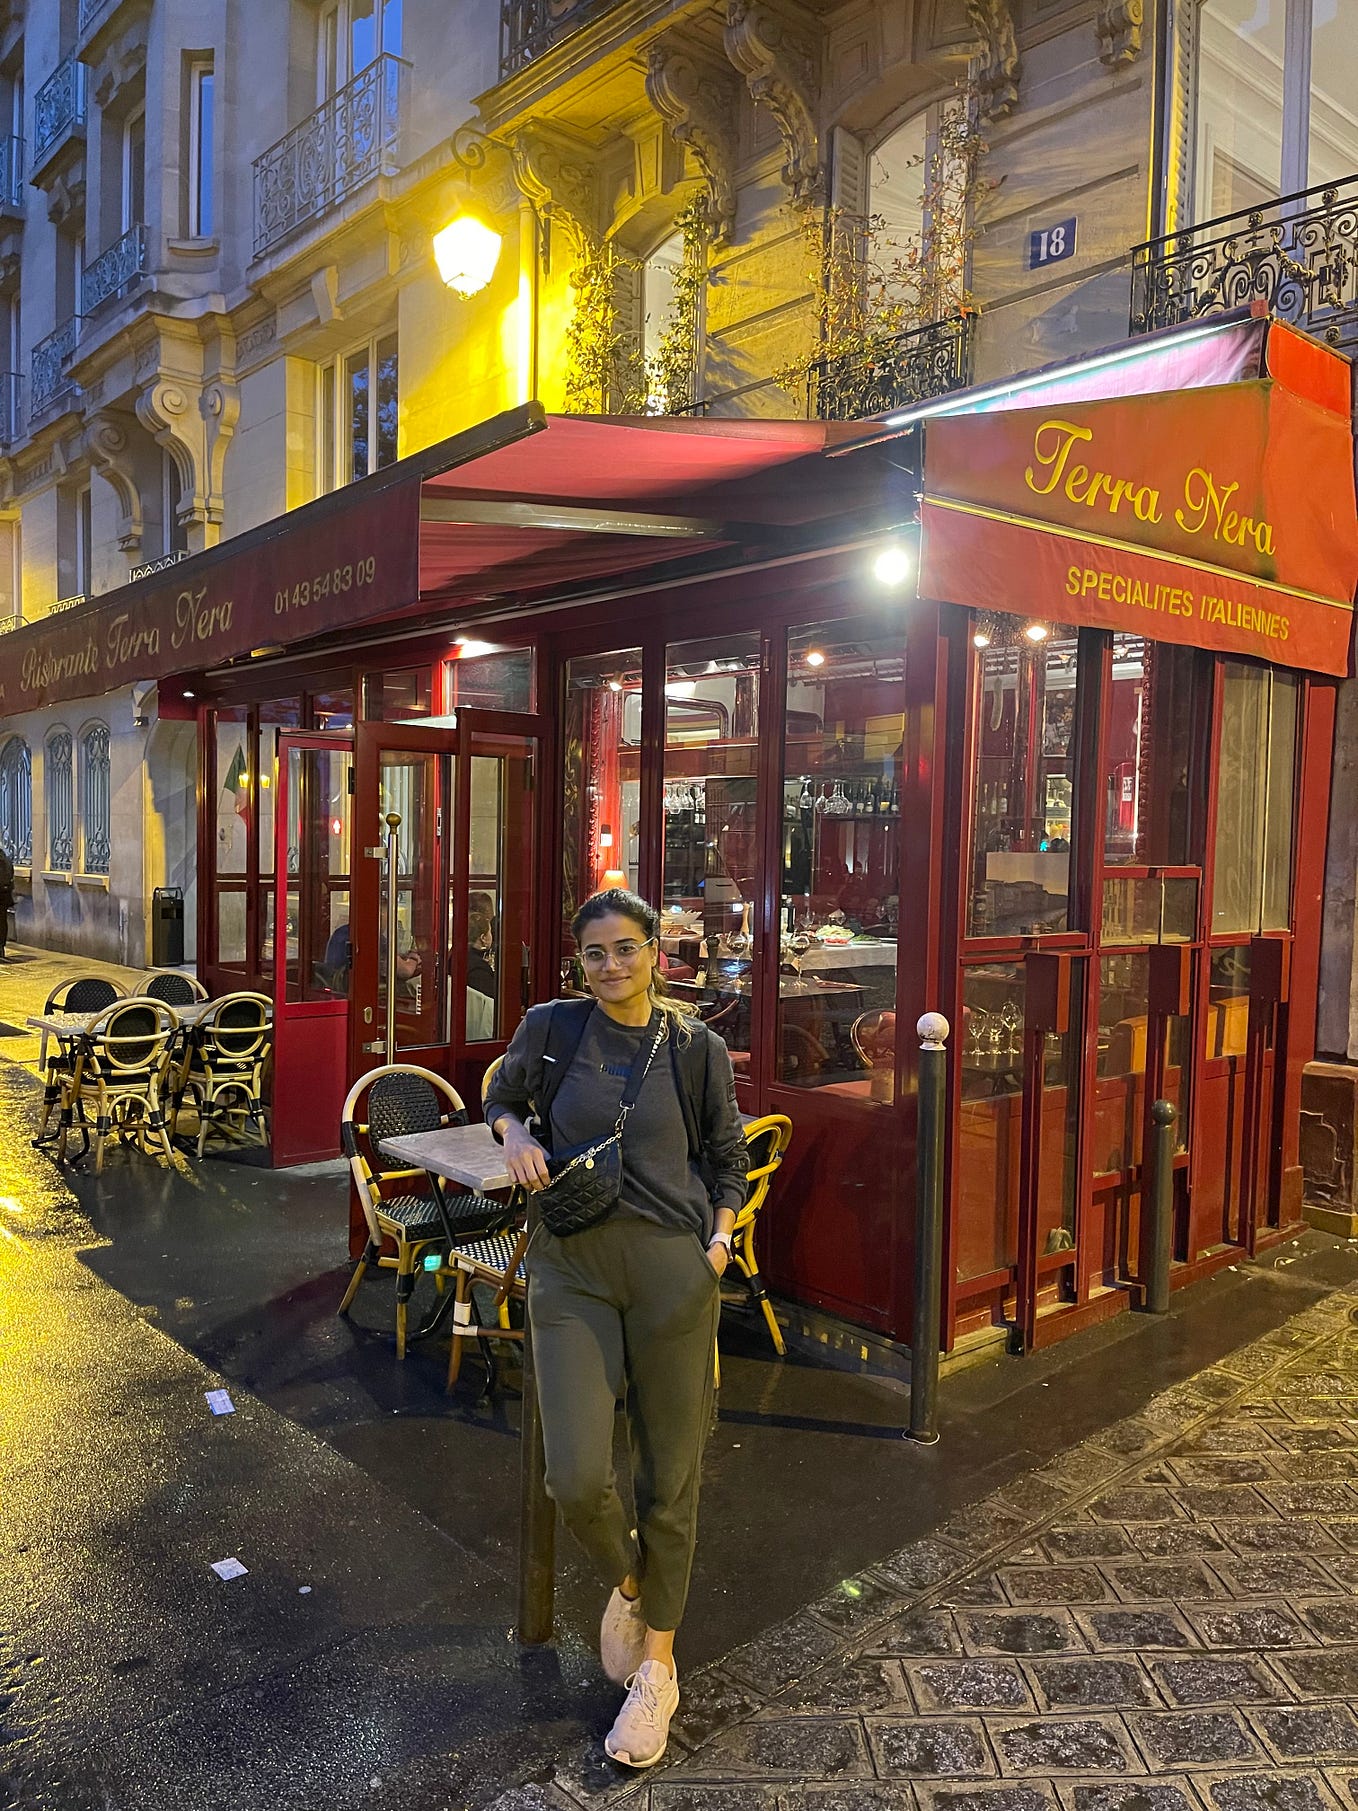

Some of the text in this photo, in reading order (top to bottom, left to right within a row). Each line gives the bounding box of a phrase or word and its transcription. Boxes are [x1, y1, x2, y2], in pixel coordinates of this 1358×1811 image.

[1039, 226, 1066, 261] 18
[1025, 420, 1276, 556] Terra Nera
[274, 556, 376, 615] 01 43 54 83 09
[1065, 566, 1290, 641] SPECIALITES ITALIENNES
[20, 587, 233, 692] Ristorante Terra Nera
